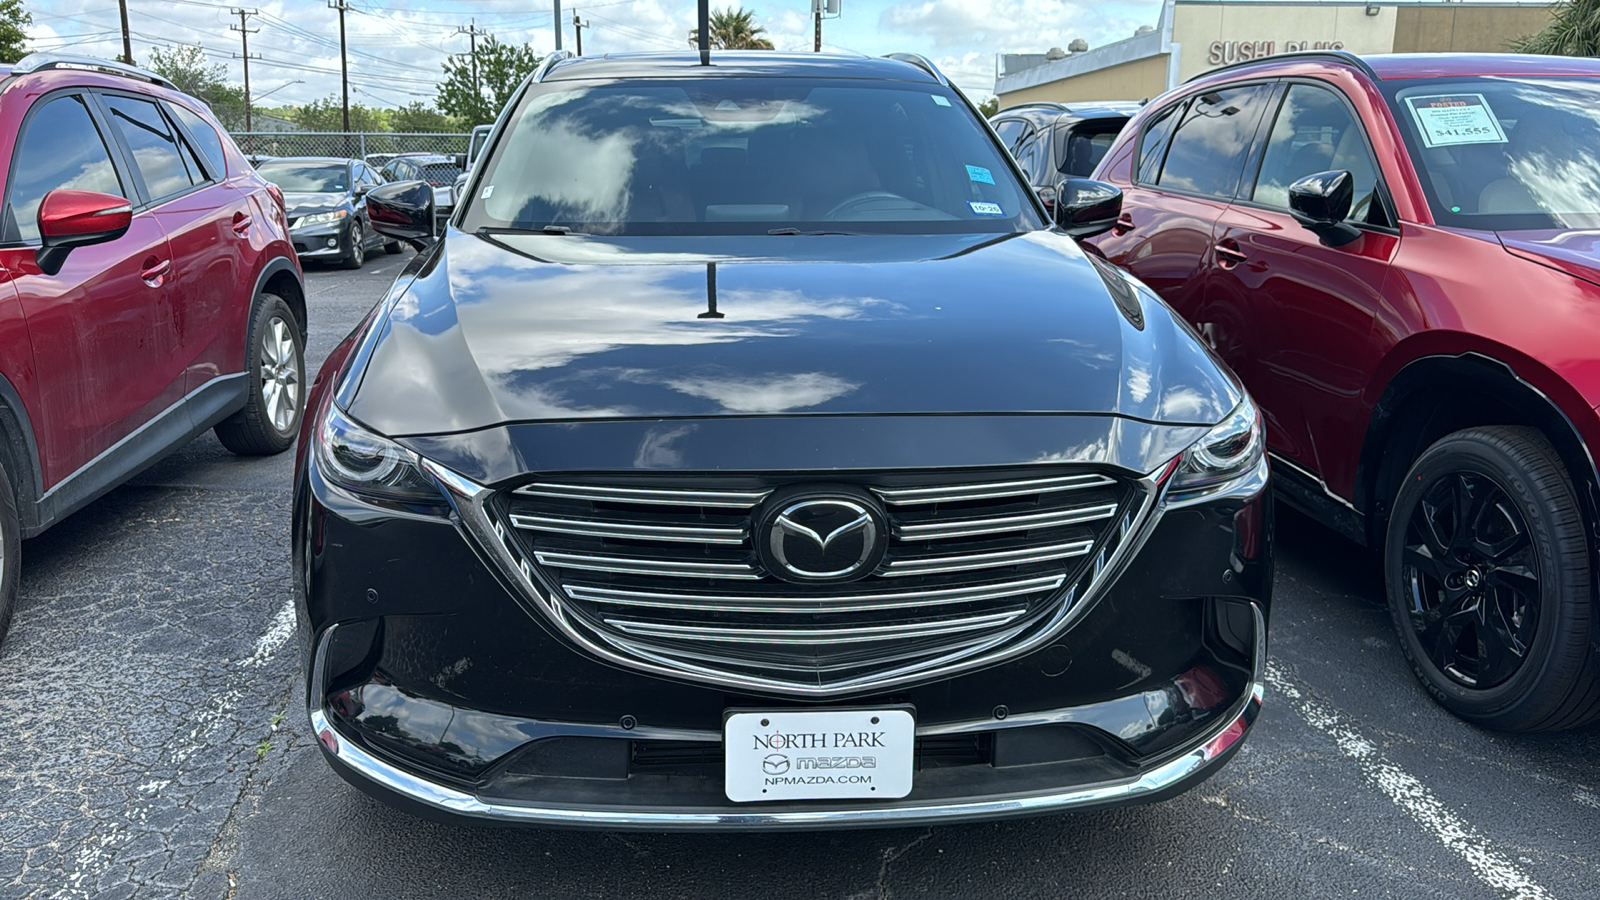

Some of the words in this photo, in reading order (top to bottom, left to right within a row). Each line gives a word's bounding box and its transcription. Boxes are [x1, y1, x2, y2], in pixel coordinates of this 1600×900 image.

[1210, 41, 1275, 65] SUSHI
[1435, 127, 1491, 136] $41,555
[752, 732, 827, 750] NORTH
[833, 731, 886, 748] PARK
[765, 775, 872, 785] NPMAZDA.COM
